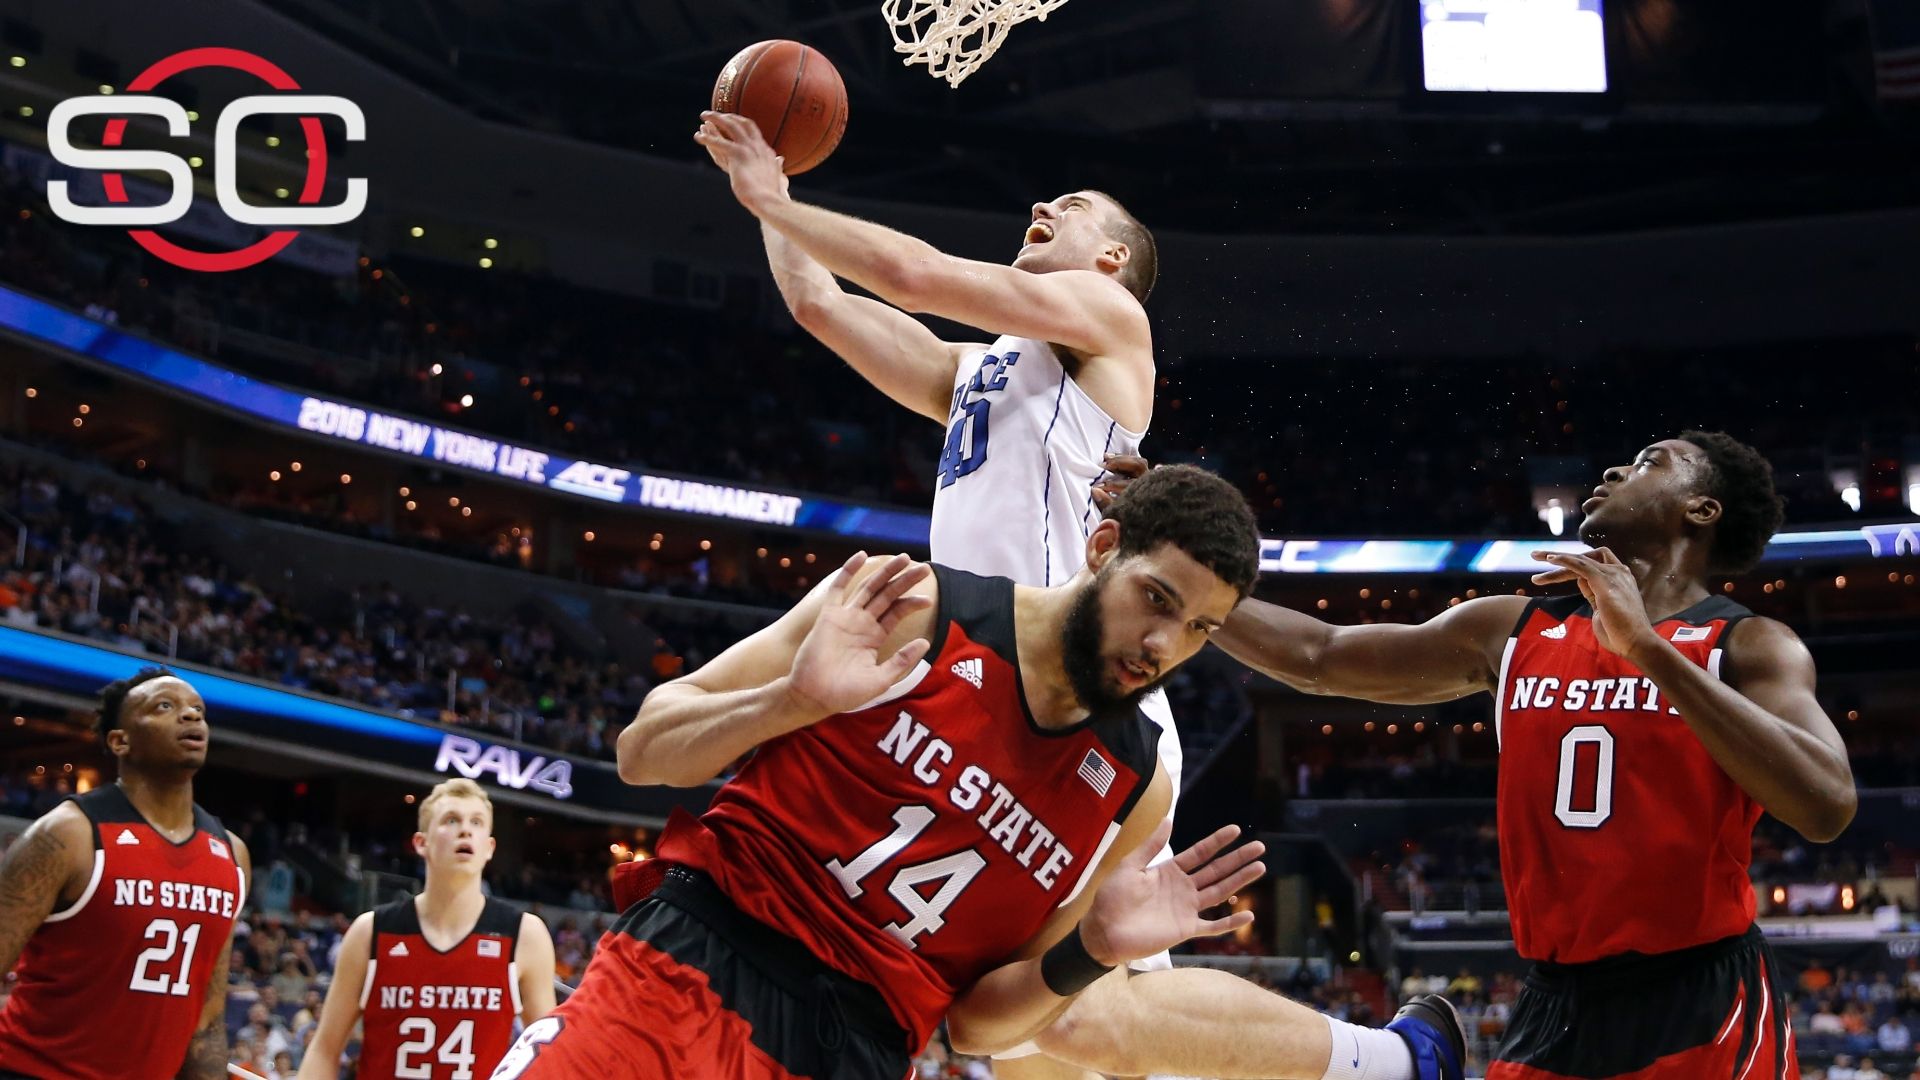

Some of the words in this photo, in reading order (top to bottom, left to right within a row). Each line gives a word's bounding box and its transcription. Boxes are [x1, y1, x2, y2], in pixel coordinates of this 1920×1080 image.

[298, 397, 367, 441] 2016
[365, 413, 432, 455] NEW
[432, 427, 498, 472] YORK
[496, 444, 550, 484] LIFE
[551, 460, 631, 495] ACC
[639, 474, 803, 526] TOURNAMENT
[936, 397, 992, 491] 40
[1258, 538, 1319, 573] CC
[1509, 676, 1561, 712] NC
[1562, 676, 1681, 716] STAT
[434, 733, 573, 800] RAV4
[876, 710, 954, 785] NC
[949, 765, 1074, 891] STATE
[1554, 725, 1614, 828] 0
[113, 878, 155, 906] NC
[159, 880, 235, 919] STATE
[825, 805, 987, 950] 14
[128, 918, 202, 996] 21
[380, 985, 415, 1009] NC
[419, 985, 503, 1011] STATE
[394, 1016, 477, 1080] 24
